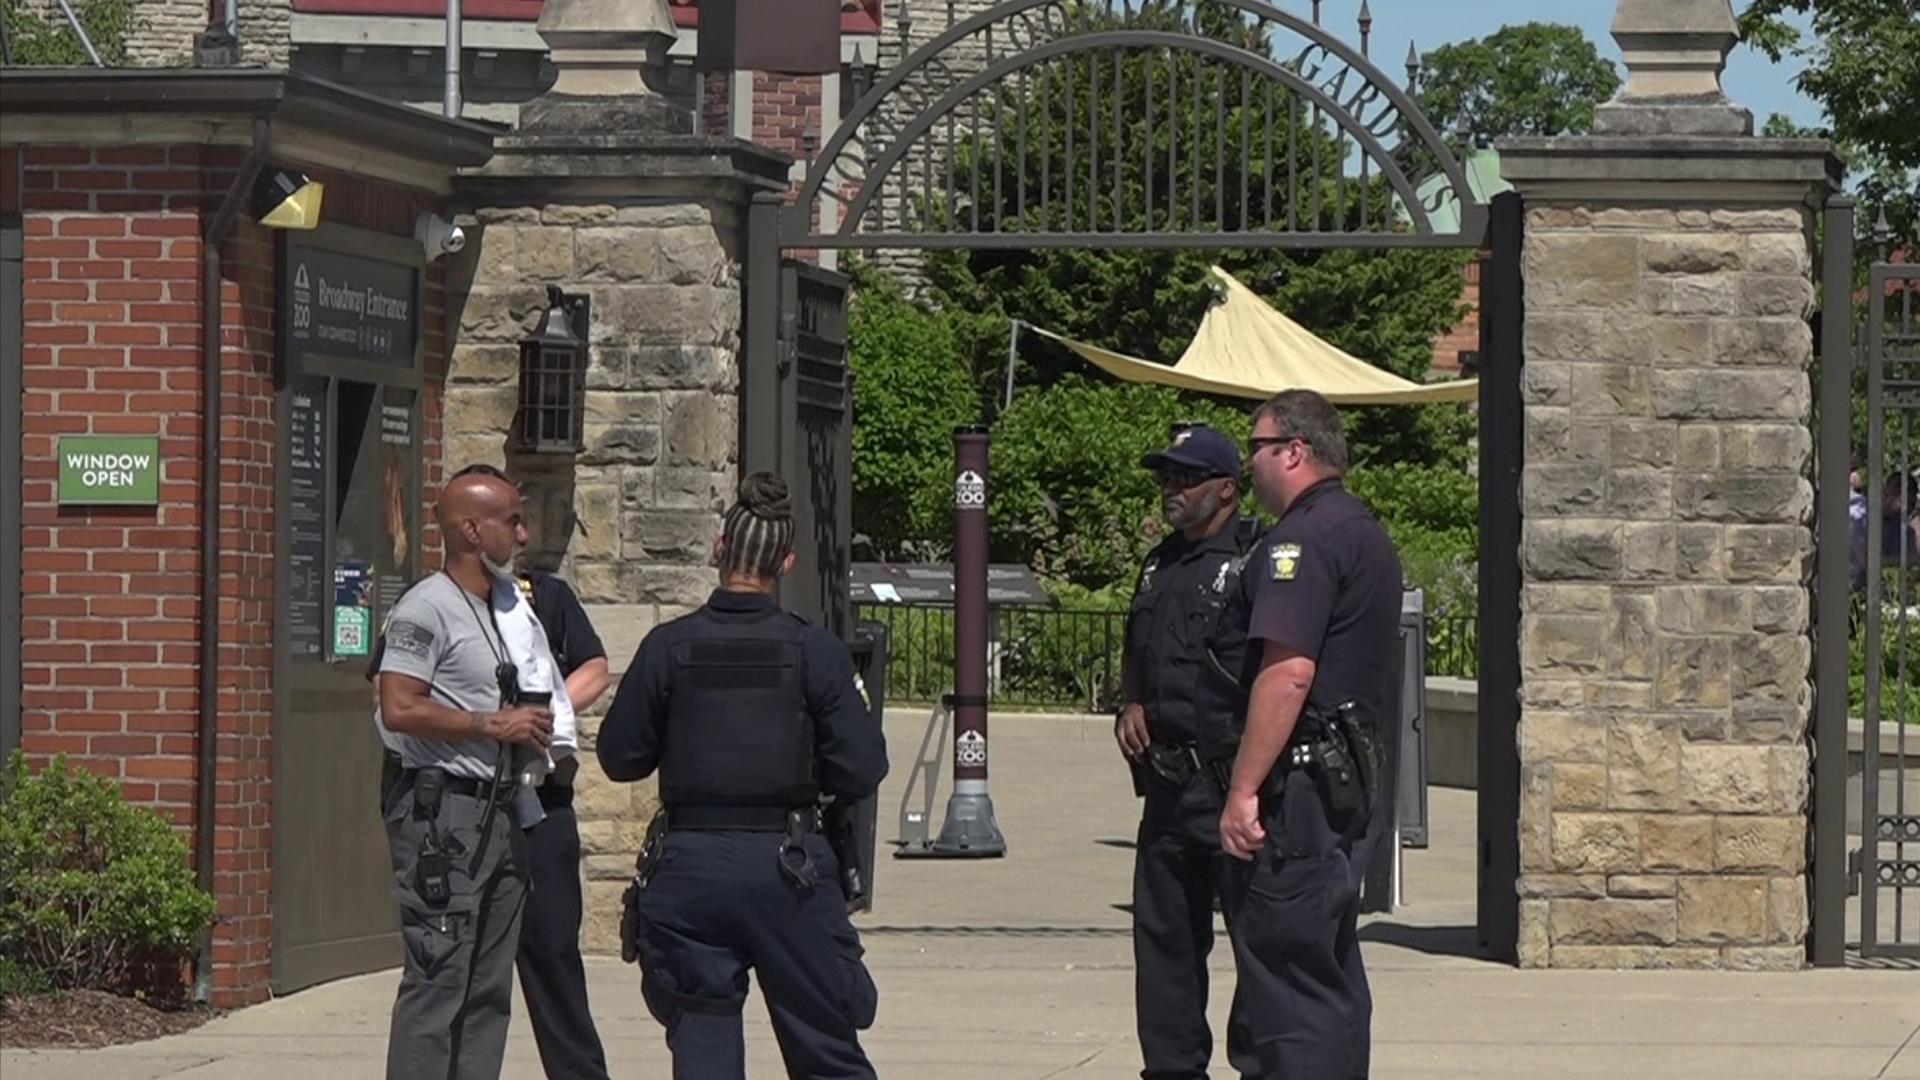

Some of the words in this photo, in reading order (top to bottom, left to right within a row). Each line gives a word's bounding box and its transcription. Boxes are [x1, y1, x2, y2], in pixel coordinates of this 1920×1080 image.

[318, 277, 366, 321] Broadway
[366, 286, 408, 321] Entrance
[293, 303, 311, 328] ZOO
[67, 453, 150, 470] WINDOW
[82, 470, 134, 487] OPEN
[956, 491, 985, 504] ZOO
[958, 750, 985, 762] ZOO
